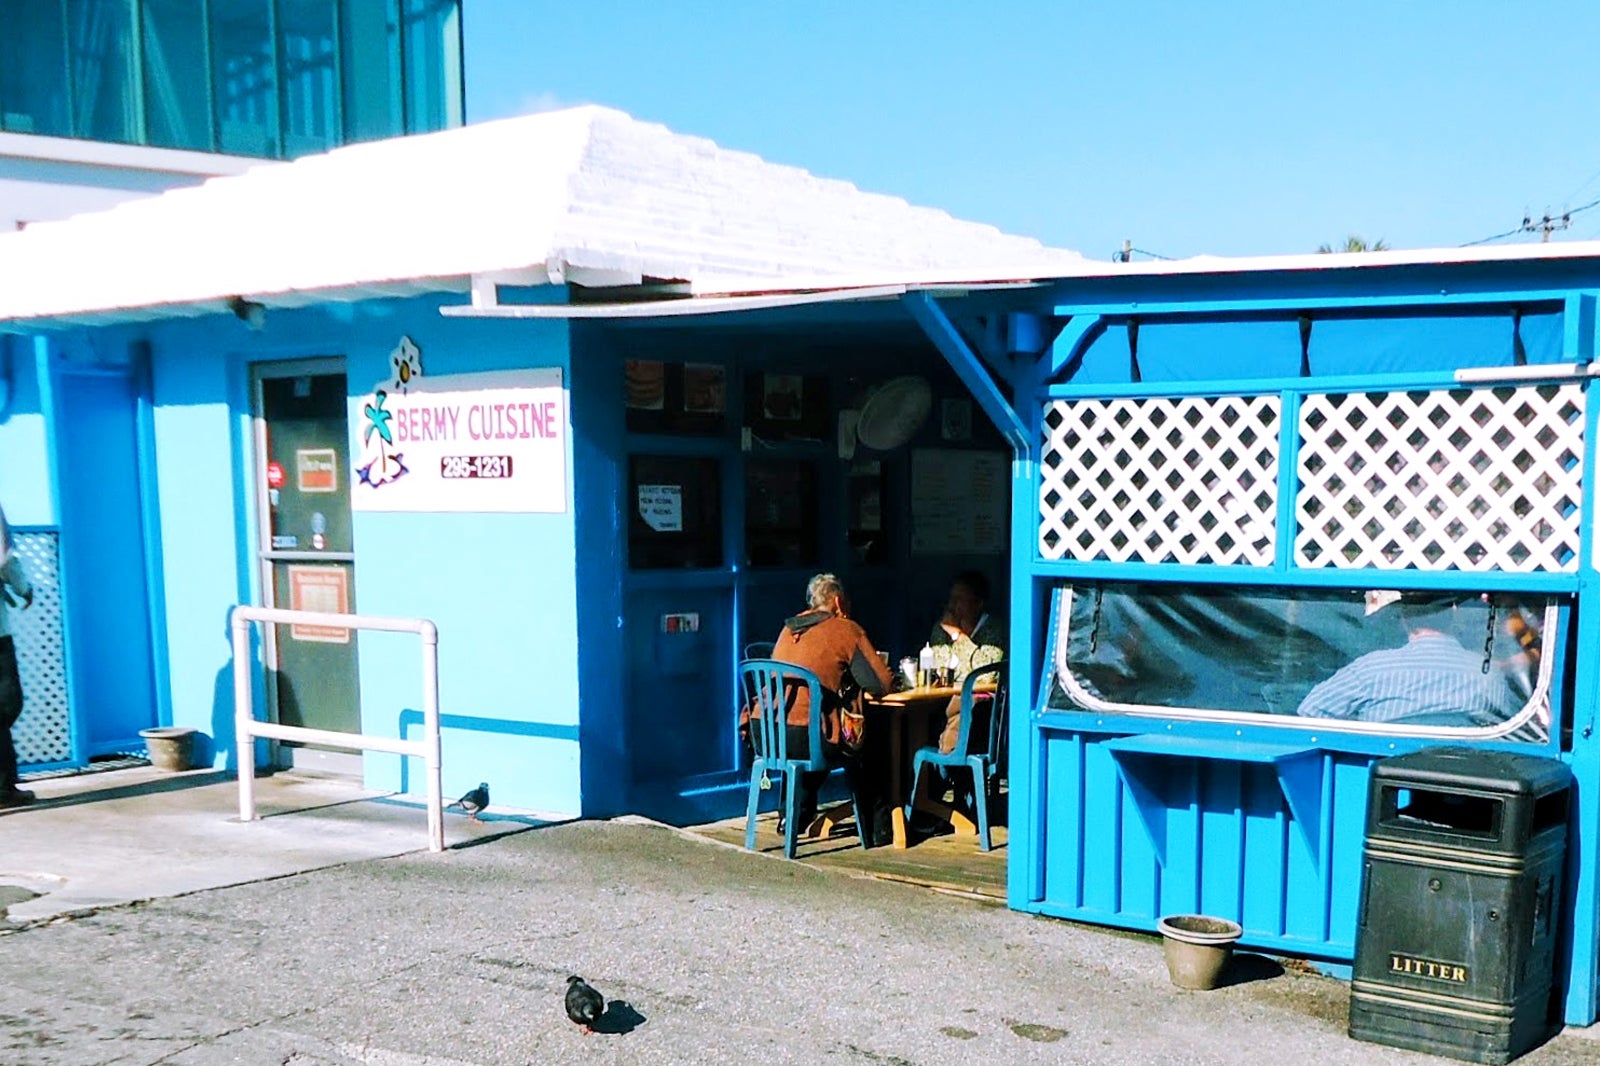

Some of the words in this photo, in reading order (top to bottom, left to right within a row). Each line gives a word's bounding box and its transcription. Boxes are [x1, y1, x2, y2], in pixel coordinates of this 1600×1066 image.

[397, 406, 460, 442] BERMY
[468, 402, 557, 440] CUISINE
[442, 456, 509, 478] 295-1231
[1392, 956, 1466, 982] LITTER
